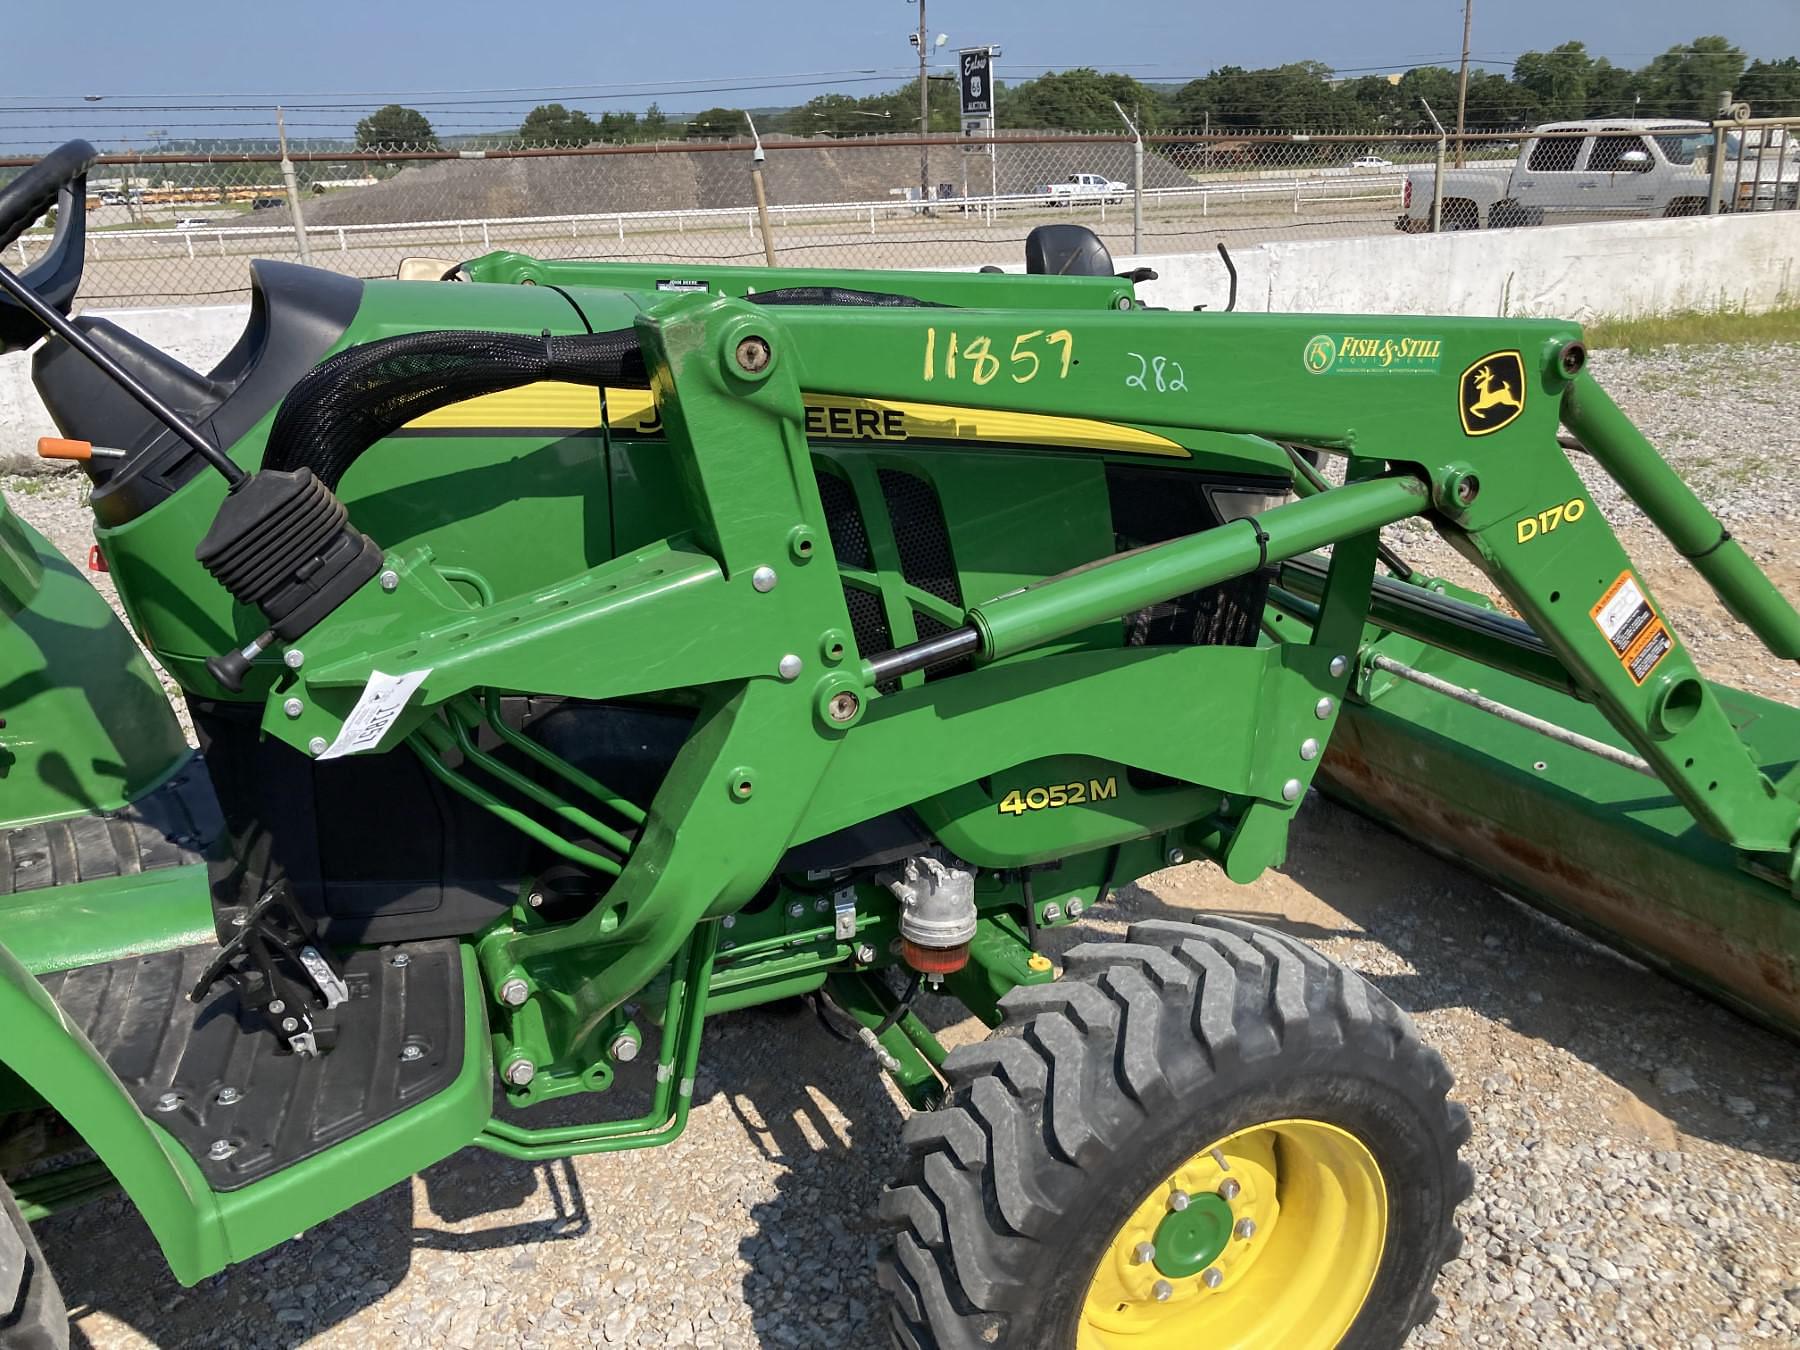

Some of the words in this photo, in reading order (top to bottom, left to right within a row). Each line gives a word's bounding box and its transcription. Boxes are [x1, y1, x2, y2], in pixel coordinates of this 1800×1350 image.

[967, 101, 987, 111] AUCTION
[923, 327, 1073, 385] 11857
[1337, 336, 1381, 357] FISH
[1397, 337, 1441, 358] STILL
[1126, 352, 1188, 392] 282
[802, 406, 907, 436] EERE
[1516, 498, 1585, 544] D170
[999, 782, 1087, 815] 4052
